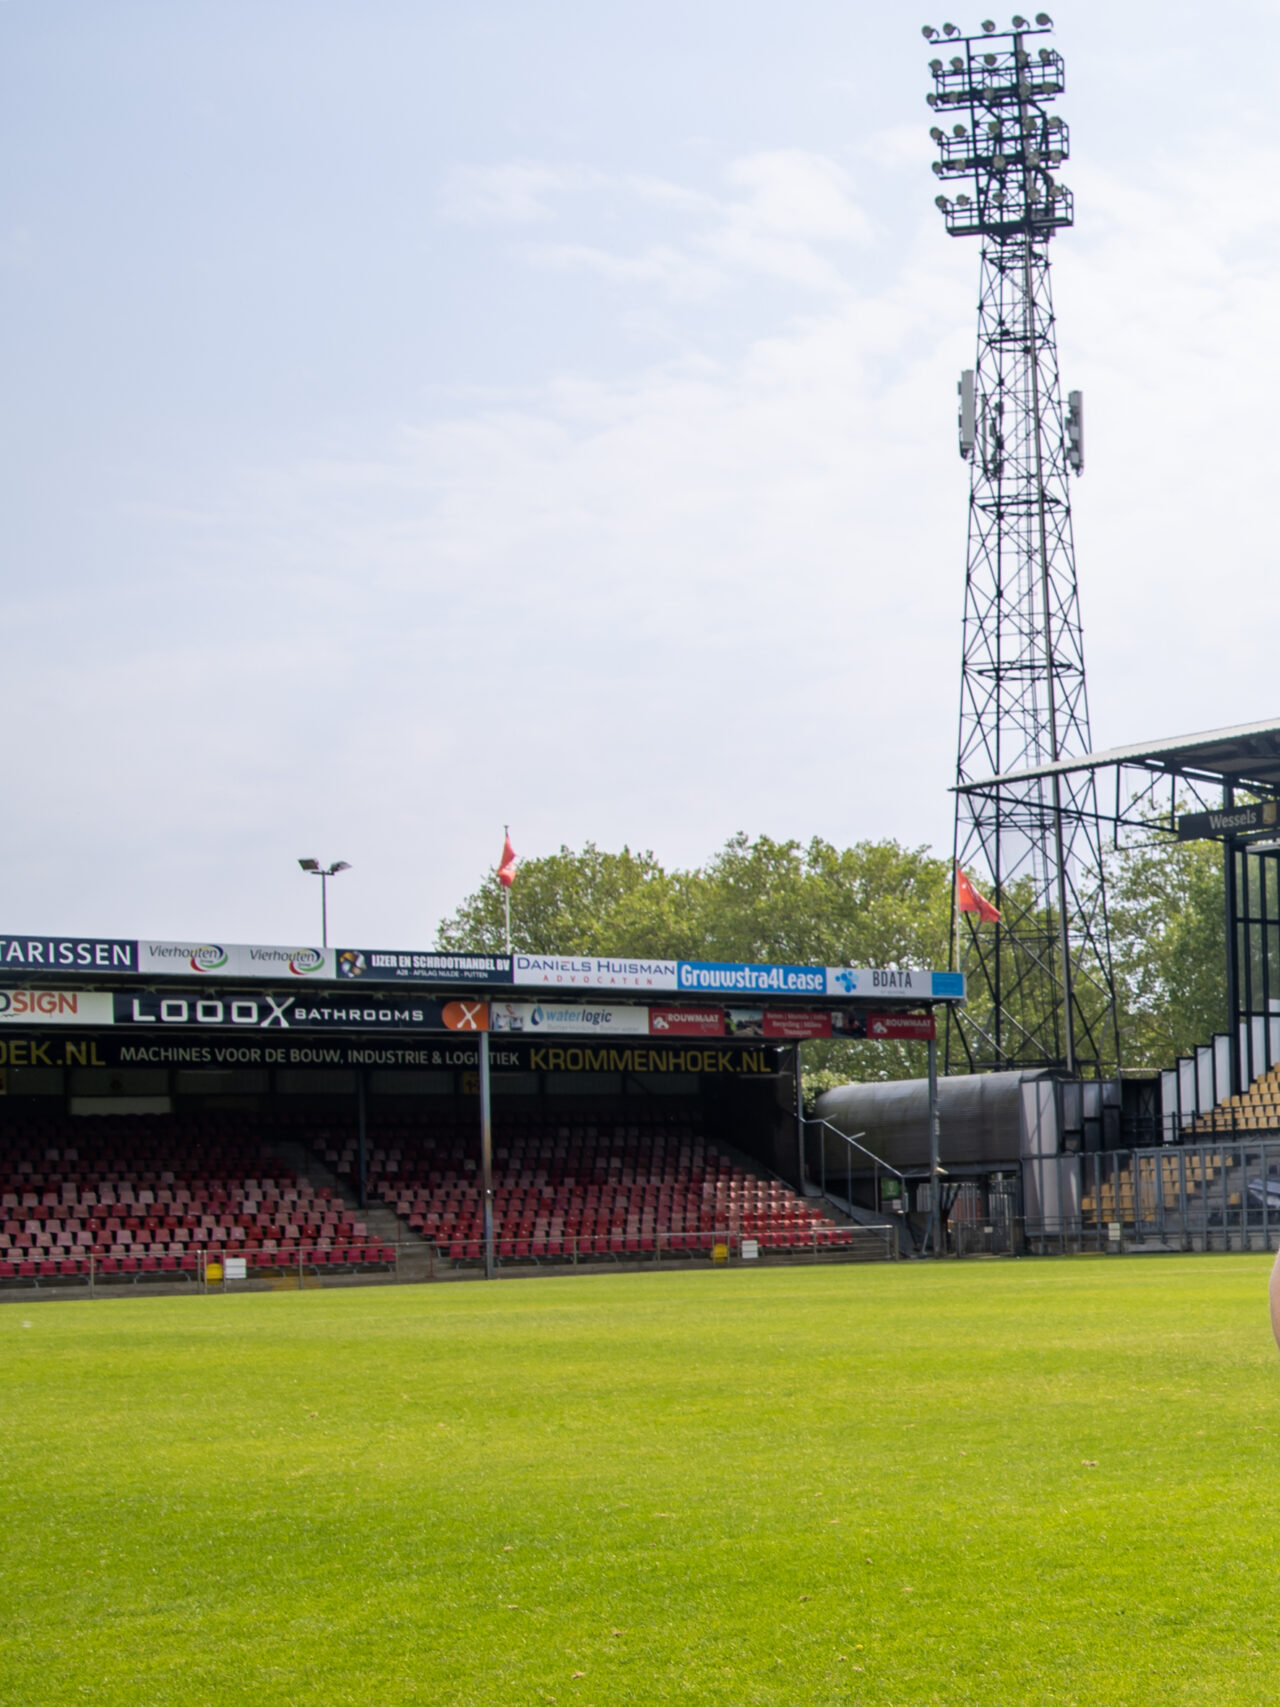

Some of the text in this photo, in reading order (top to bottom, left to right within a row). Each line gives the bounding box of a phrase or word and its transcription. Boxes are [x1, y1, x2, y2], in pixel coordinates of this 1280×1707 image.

[1209, 808, 1257, 830] Wessels
[149, 945, 218, 959] Vierhouten
[250, 949, 316, 963] Vierhouten
[398, 955, 412, 968] EN
[413, 956, 495, 970] SCHROOTHANDEL
[496, 959, 511, 971] BV
[680, 964, 824, 991] Grouwstra4Lease
[872, 970, 913, 988] BDATA
[132, 997, 424, 1027] LOOOX BATHROOMS
[546, 1008, 612, 1026] waterlogic
[668, 1013, 719, 1023] ROUWMAAT
[120, 1046, 520, 1065] MACHINES VOOR DE BOUW, INDUSTRIE & LOGITIEK
[530, 1047, 771, 1073] KROMMENHOEK.NL
